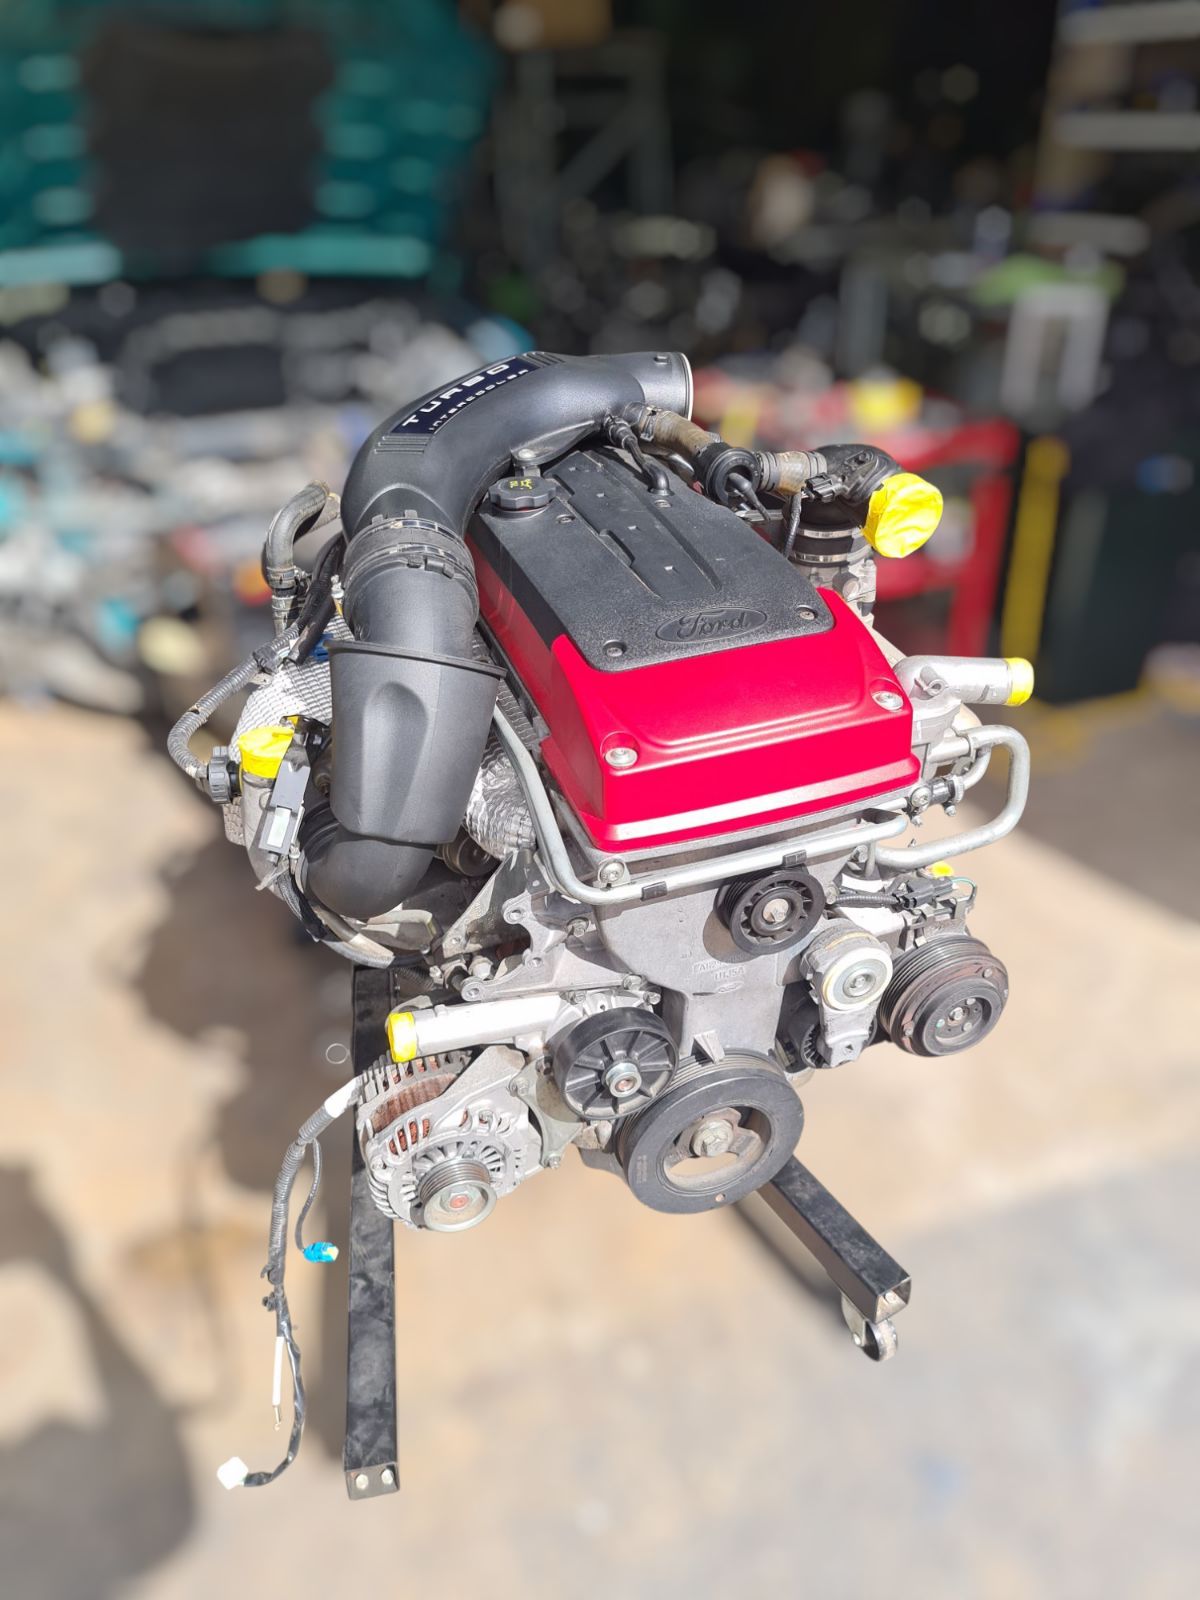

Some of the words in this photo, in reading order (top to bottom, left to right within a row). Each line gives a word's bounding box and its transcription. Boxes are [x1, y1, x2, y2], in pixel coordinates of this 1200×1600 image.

[402, 364, 509, 426] TURBO
[428, 369, 529, 430] INTERCOOLER
[676, 610, 748, 640] Ford
